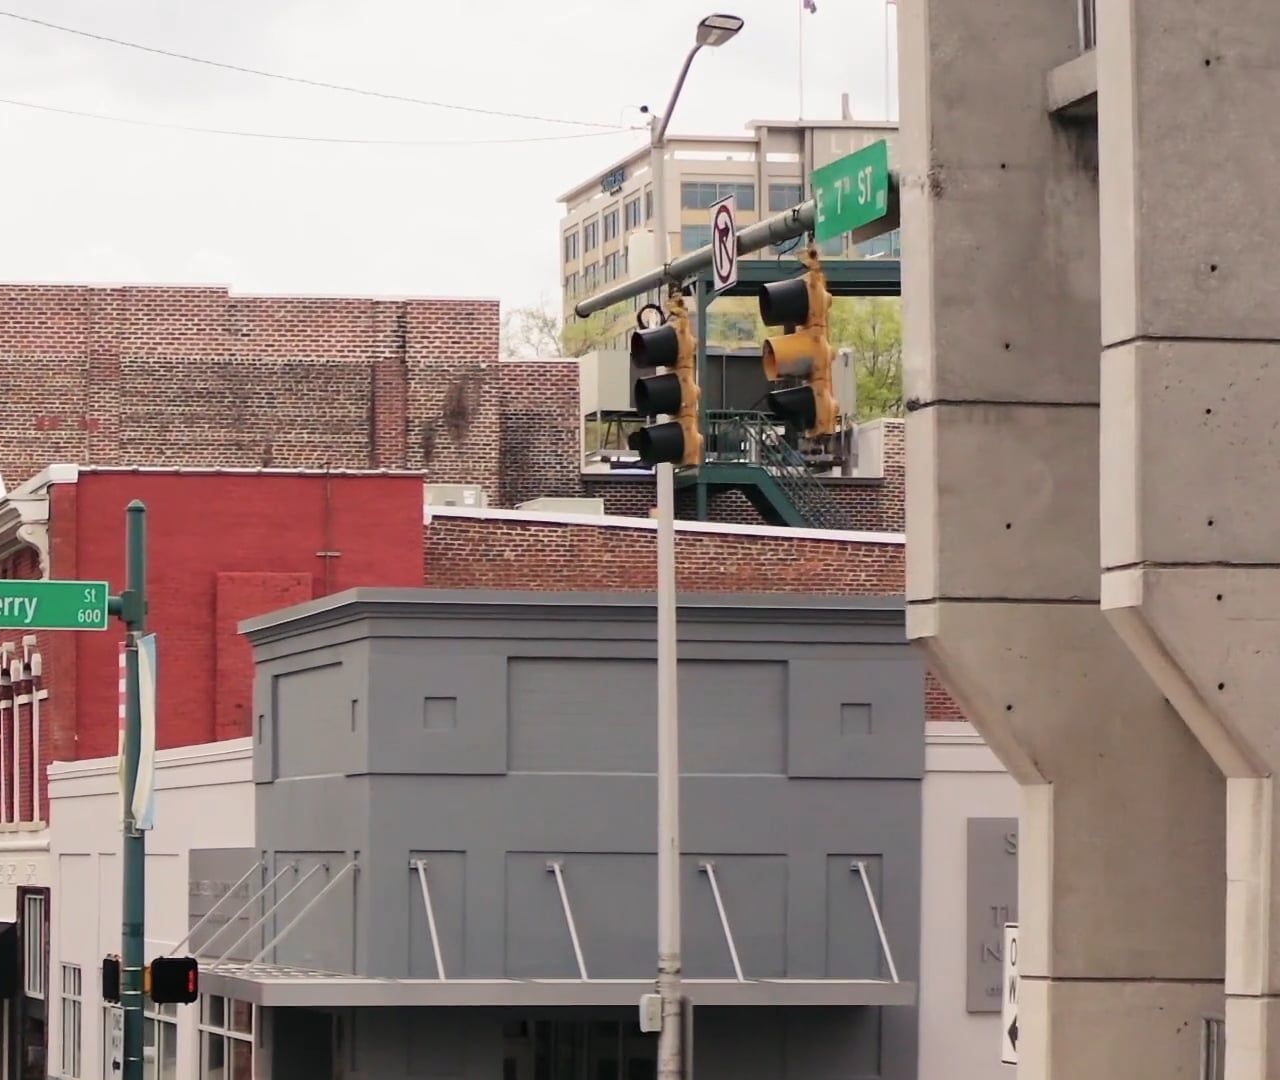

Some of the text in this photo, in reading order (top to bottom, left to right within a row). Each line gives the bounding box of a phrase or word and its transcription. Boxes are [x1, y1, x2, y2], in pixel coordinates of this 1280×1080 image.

[816, 188, 825, 223] E
[858, 165, 873, 206] ST
[84, 588, 96, 603] St
[77, 609, 101, 623] 600
